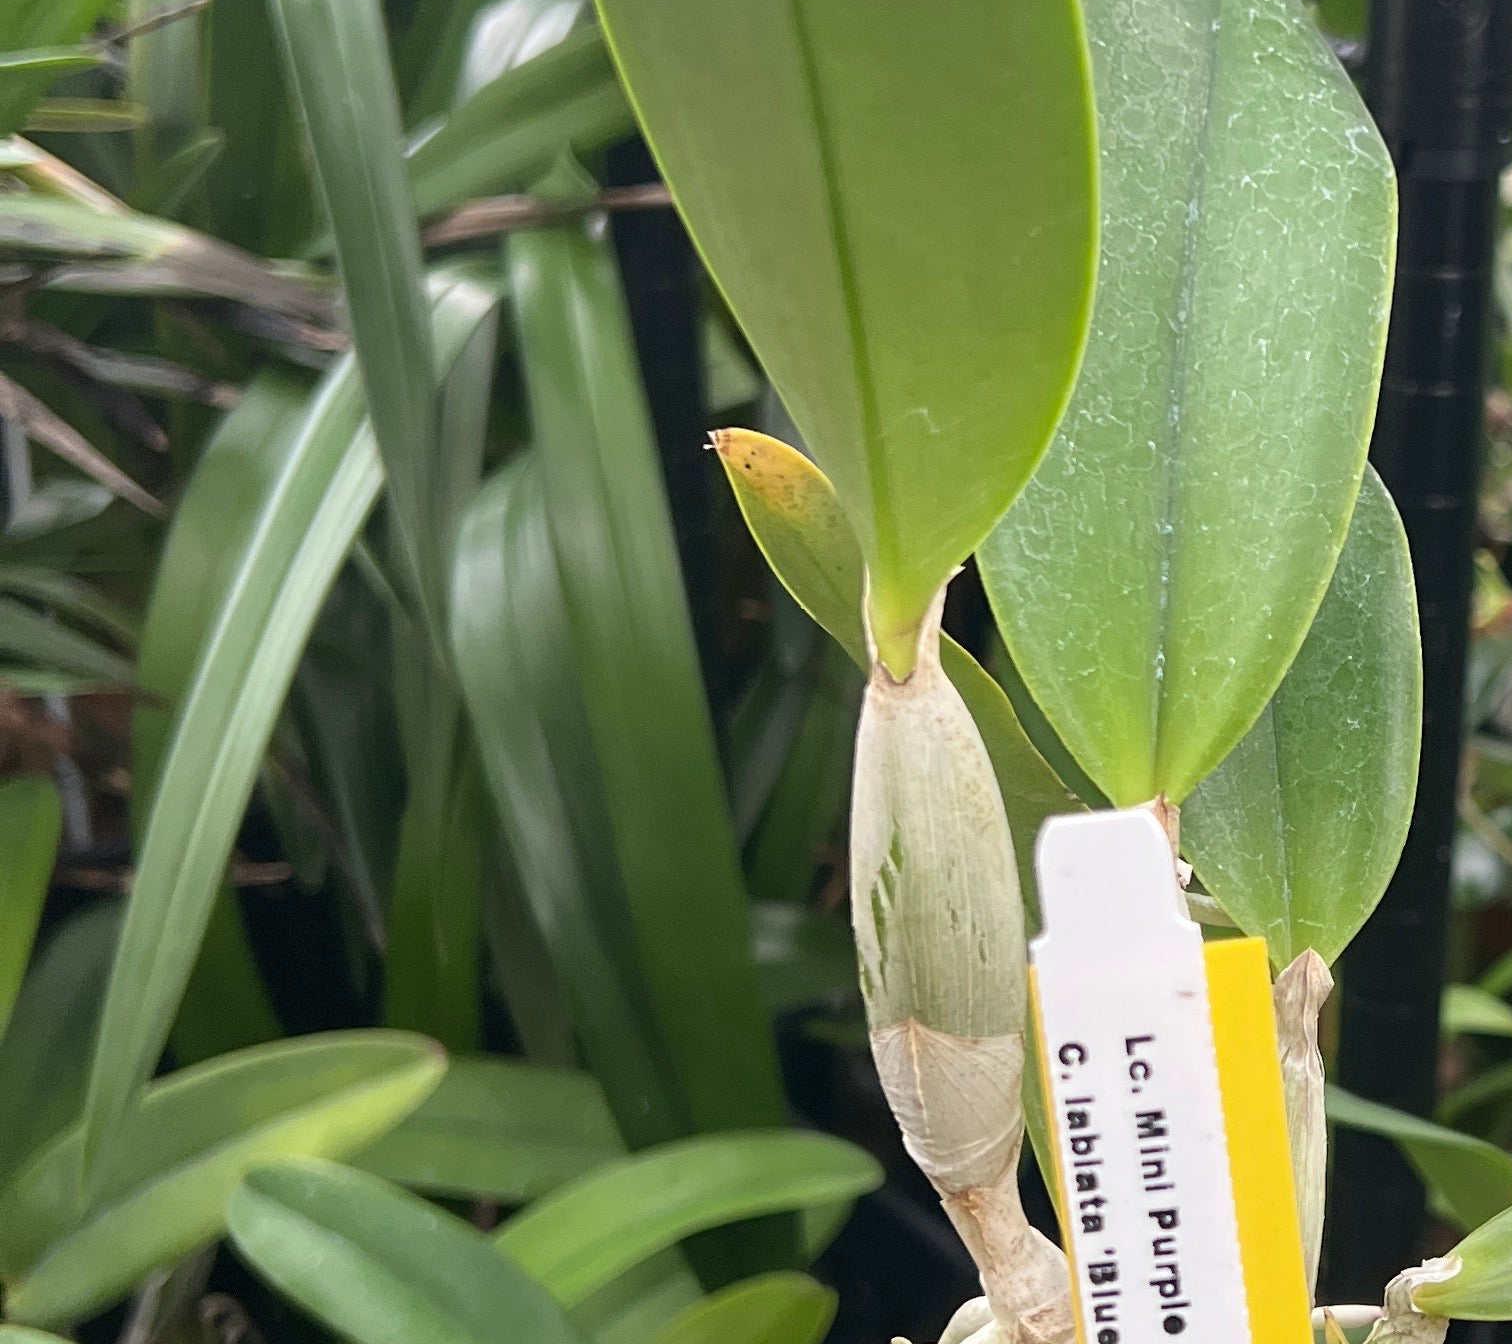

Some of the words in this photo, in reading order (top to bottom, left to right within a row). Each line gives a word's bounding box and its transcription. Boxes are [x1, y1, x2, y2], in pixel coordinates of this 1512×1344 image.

[1058, 1042, 1087, 1080] C.
[1125, 1035, 1154, 1094] Lc.
[1064, 1097, 1107, 1234] labiata
[1135, 1110, 1174, 1192] Mini
[1148, 1208, 1190, 1336] Purple
